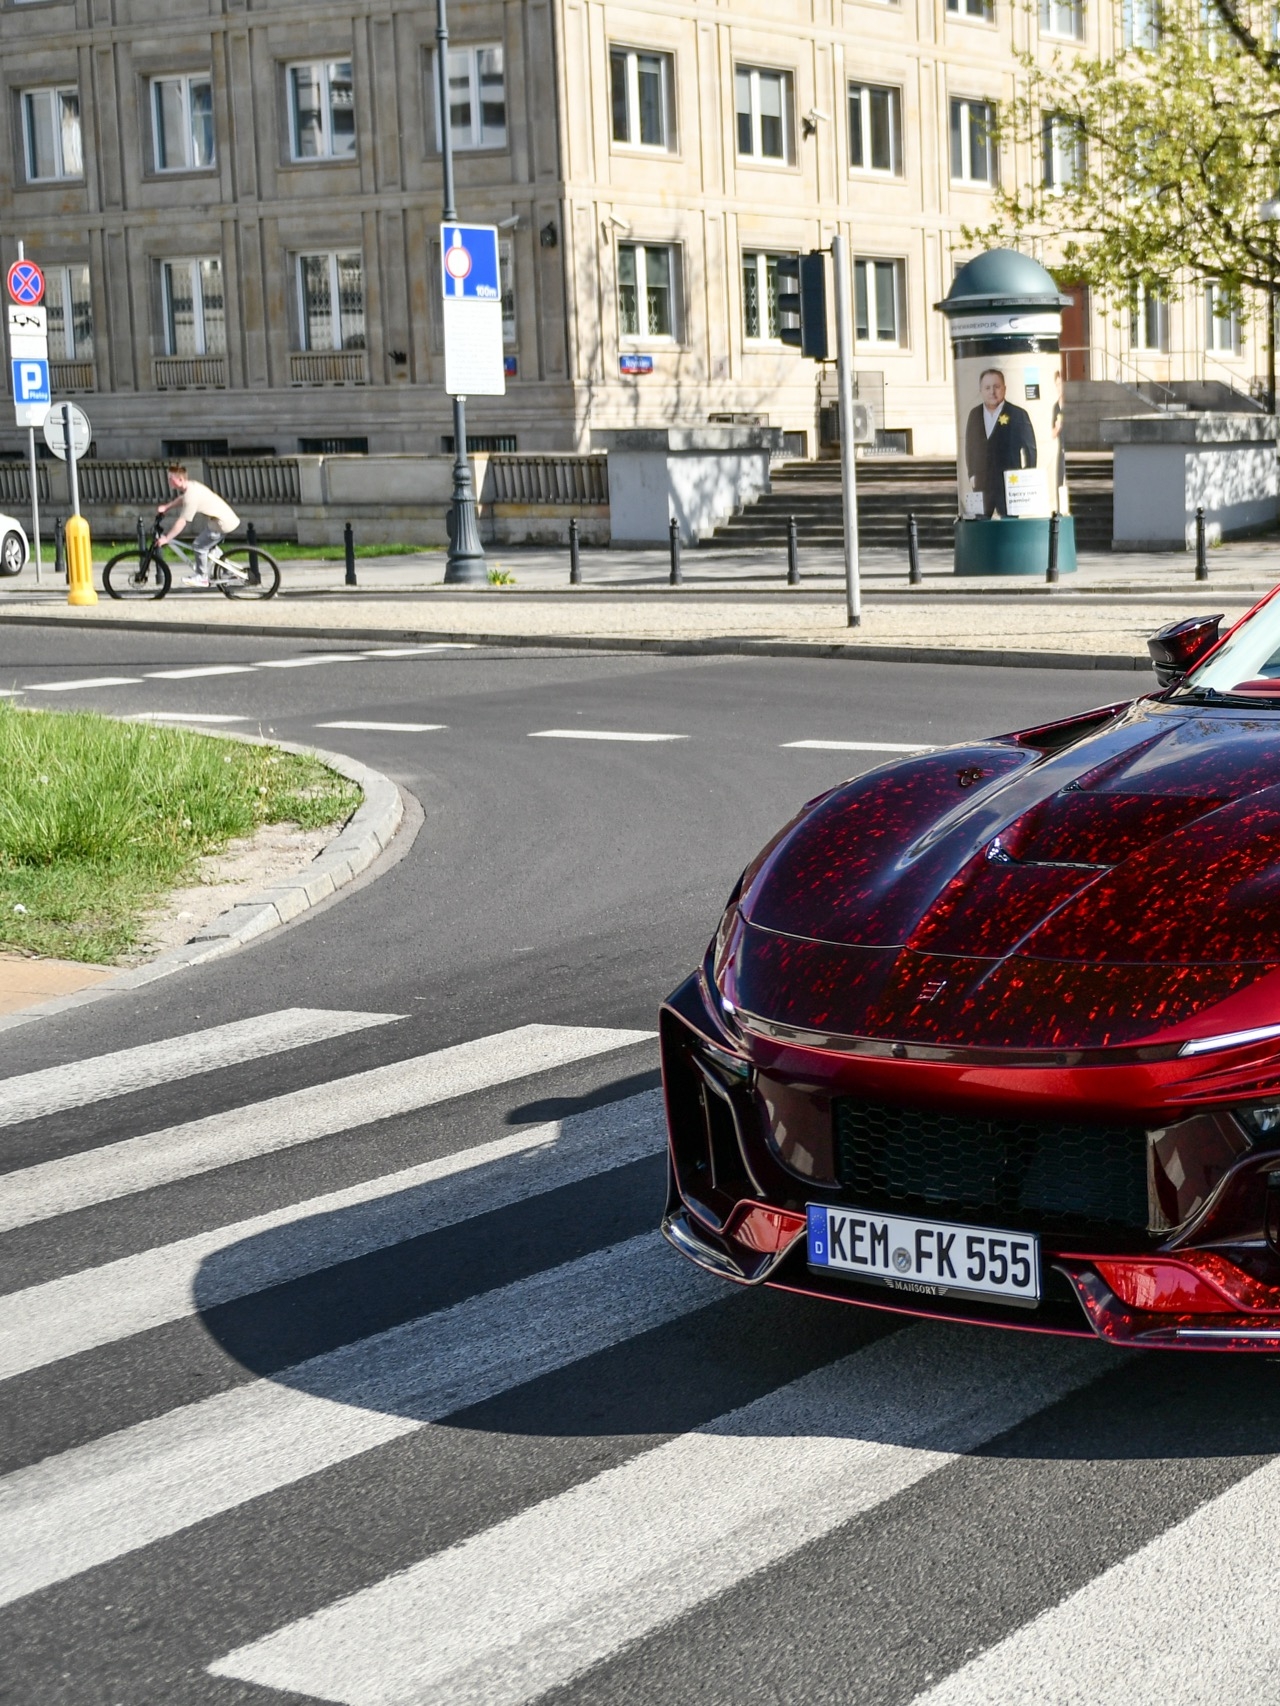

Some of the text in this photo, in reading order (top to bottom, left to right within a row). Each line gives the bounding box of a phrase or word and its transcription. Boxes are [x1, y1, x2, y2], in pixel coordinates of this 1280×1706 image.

[476, 285, 497, 297] 100m
[20, 362, 42, 400] P
[815, 1241, 823, 1254] D
[829, 1215, 1030, 1288] KEM FK 555
[894, 1281, 937, 1296] MANSORY
